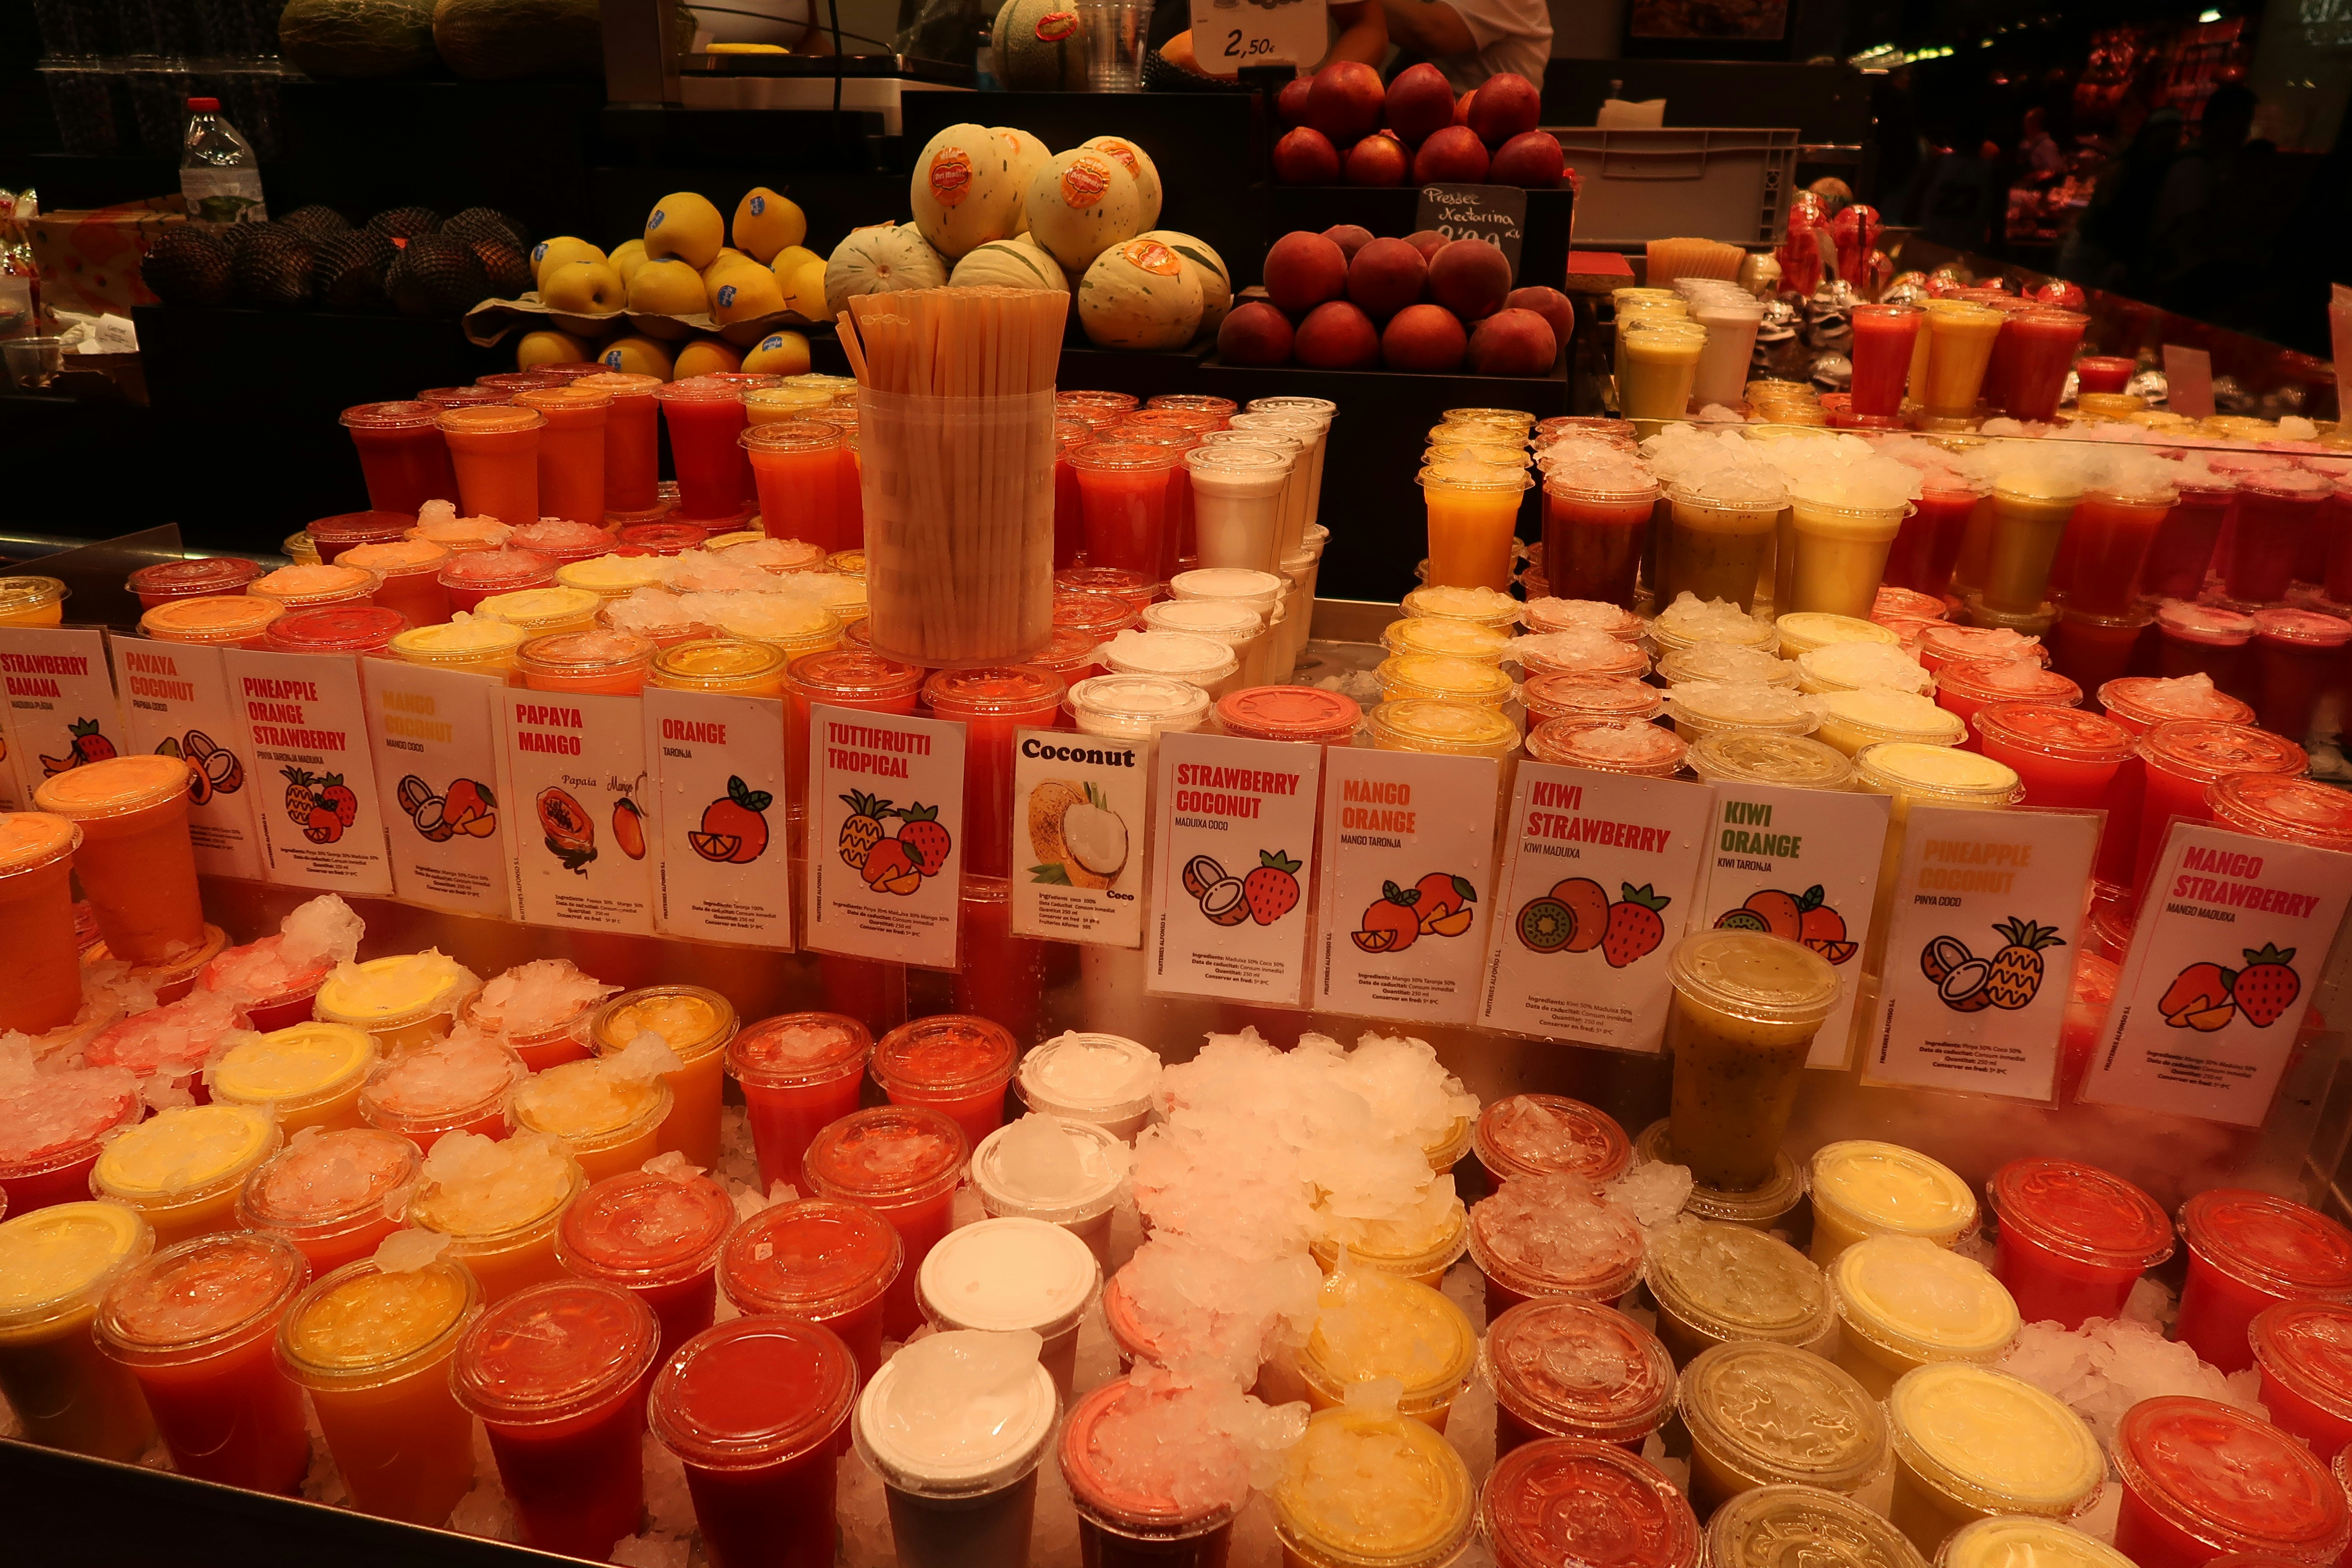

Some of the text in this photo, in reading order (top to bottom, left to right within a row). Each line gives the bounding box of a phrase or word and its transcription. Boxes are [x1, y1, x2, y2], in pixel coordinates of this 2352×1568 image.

[1439, 207, 1515, 226] Nectarina
[0, 653, 89, 675] STRAWBERRY
[126, 652, 178, 676] PAYAYA
[6, 677, 61, 697] BANANA
[130, 676, 194, 701] COCONUT
[243, 677, 318, 701] PINEAPPLE
[248, 701, 304, 724] ORANGE
[382, 690, 435, 716] MANGO
[516, 704, 583, 728] PAPAYA
[252, 726, 346, 751] STRAWBERRY
[384, 714, 452, 743] COCONUT
[662, 718, 726, 744] ORANGE
[828, 722, 931, 756] TUTTIFRUTTI
[386, 739, 424, 752] MANGO COCO
[518, 732, 581, 756] MANGO
[663, 747, 692, 759] TARONJA
[1022, 739, 1135, 768] Coconut
[257, 751, 324, 764] PINYA TARONJA MADUIXA
[828, 748, 909, 779] TROPICAL
[561, 775, 634, 797] Papaia Mango
[1177, 763, 1300, 796] STRAWBERRY
[1176, 790, 1262, 819] COCONUT
[1344, 780, 1411, 806] MANGO
[1532, 781, 1583, 810] KIWI
[1175, 817, 1228, 831] MADUIXA COCO
[1341, 807, 1416, 834] ORANGE
[1724, 801, 1772, 827] KIWI
[1341, 834, 1401, 848] MANGO TARONJA
[1527, 812, 1671, 854] STRAWBERRY
[1720, 829, 1802, 859] ORANGE
[1524, 842, 1580, 859] KIWI MADUIXA
[1923, 839, 2033, 867] PINEAPPLE
[1717, 857, 1772, 872] KIWI TARONJA
[2182, 846, 2264, 880] MANGO
[1918, 867, 2016, 894] COCONUT
[1106, 890, 1134, 901] Coco
[1914, 894, 1962, 907] PINYA COCO
[2173, 874, 2321, 919] STRAWBERRY
[2166, 902, 2236, 923] MANGO MADUIXA
[1192, 952, 1225, 961] Ingredients:
[1485, 985, 1495, 1017] FRUITERIES
[1490, 958, 1500, 985] ALFONSO
[1528, 995, 1565, 1006] Ingredients:
[1593, 1005, 1618, 1014] Maduixa
[1550, 1007, 1580, 1015] caducitat:
[1581, 1011, 1605, 1019] Consum
[1606, 1015, 1633, 1023] inmediat
[1539, 1020, 1569, 1029] Conservar
[1880, 1034, 1889, 1064] FRUITERIES
[1885, 1008, 1894, 1034] ALFONSO
[2104, 1041, 2119, 1071] FRUITERIES
[2115, 1015, 2128, 1041] ALFONSO
